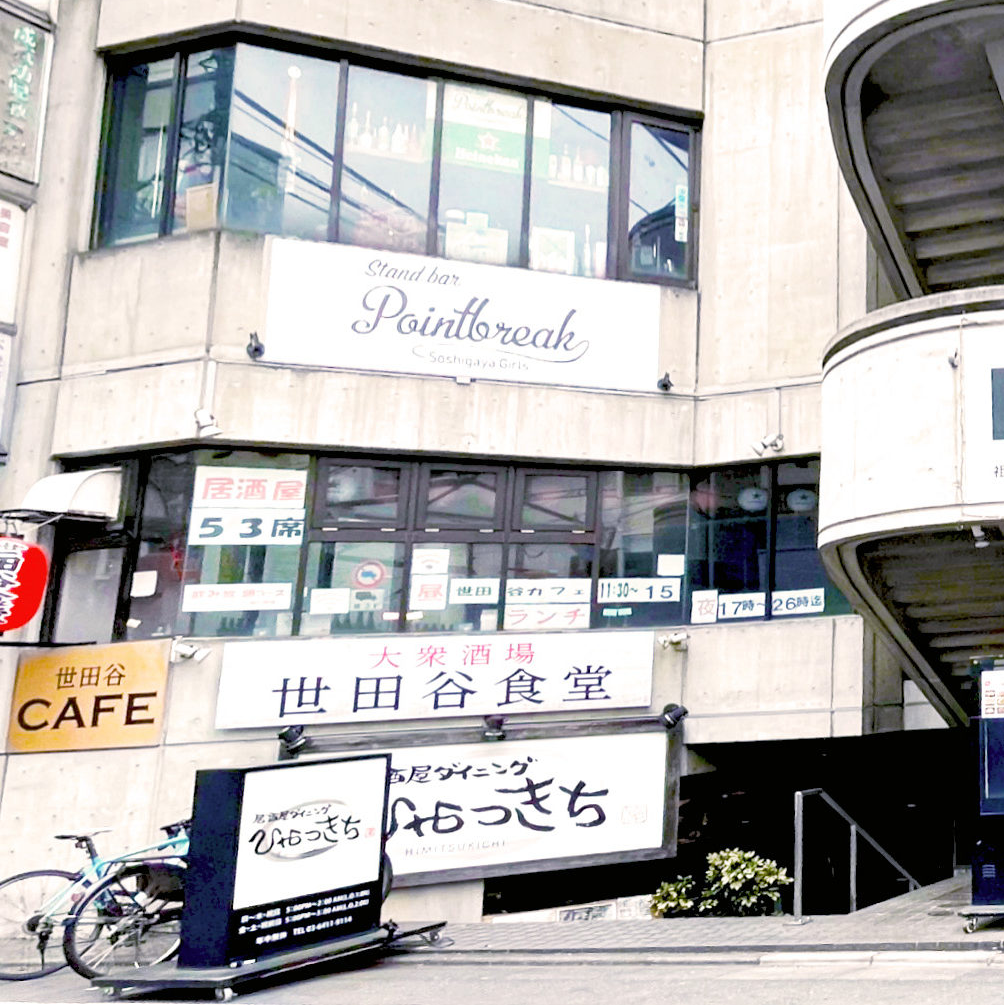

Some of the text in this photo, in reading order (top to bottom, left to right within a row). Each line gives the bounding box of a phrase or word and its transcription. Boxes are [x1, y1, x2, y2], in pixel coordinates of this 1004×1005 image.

[365, 259, 461, 286] Stand bar
[351, 285, 589, 362] Pointbreak
[429, 351, 530, 371] Soshigaya Girls
[202, 477, 304, 501] 居酒屋
[199, 517, 305, 539] 53席
[417, 583, 443, 602] 昼
[507, 608, 585, 625] ランチ
[698, 599, 716, 617] 夜
[369, 643, 535, 669] 大衆酒場
[56, 663, 126, 690] 世田谷
[271, 664, 612, 718] 世田谷食堂
[17, 691, 157, 731] CAFE
